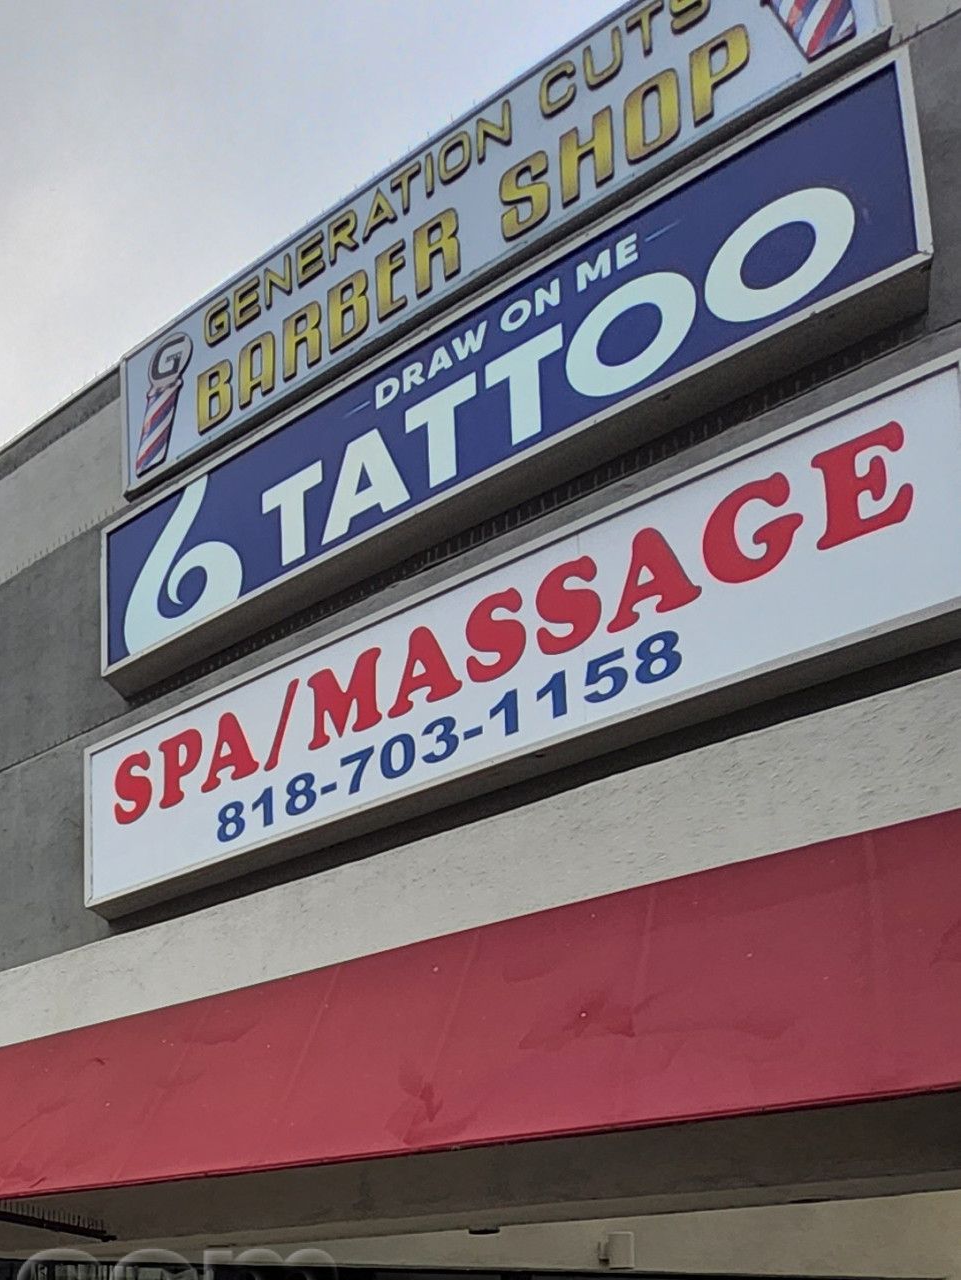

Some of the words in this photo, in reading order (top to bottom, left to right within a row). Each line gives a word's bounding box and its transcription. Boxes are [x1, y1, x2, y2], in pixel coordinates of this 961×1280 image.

[196, 207, 460, 435] BARBER
[499, 23, 751, 242] SHOP
[203, 101, 513, 348] GENERATION
[539, 0, 712, 119] CUTS
[374, 323, 487, 408] DRAW
[500, 284, 561, 334] ON
[576, 232, 638, 291] ME
[261, 187, 856, 567] TATTOO
[113, 420, 915, 826] SPA/MASSAGE
[216, 630, 684, 845] 818-703-1158
